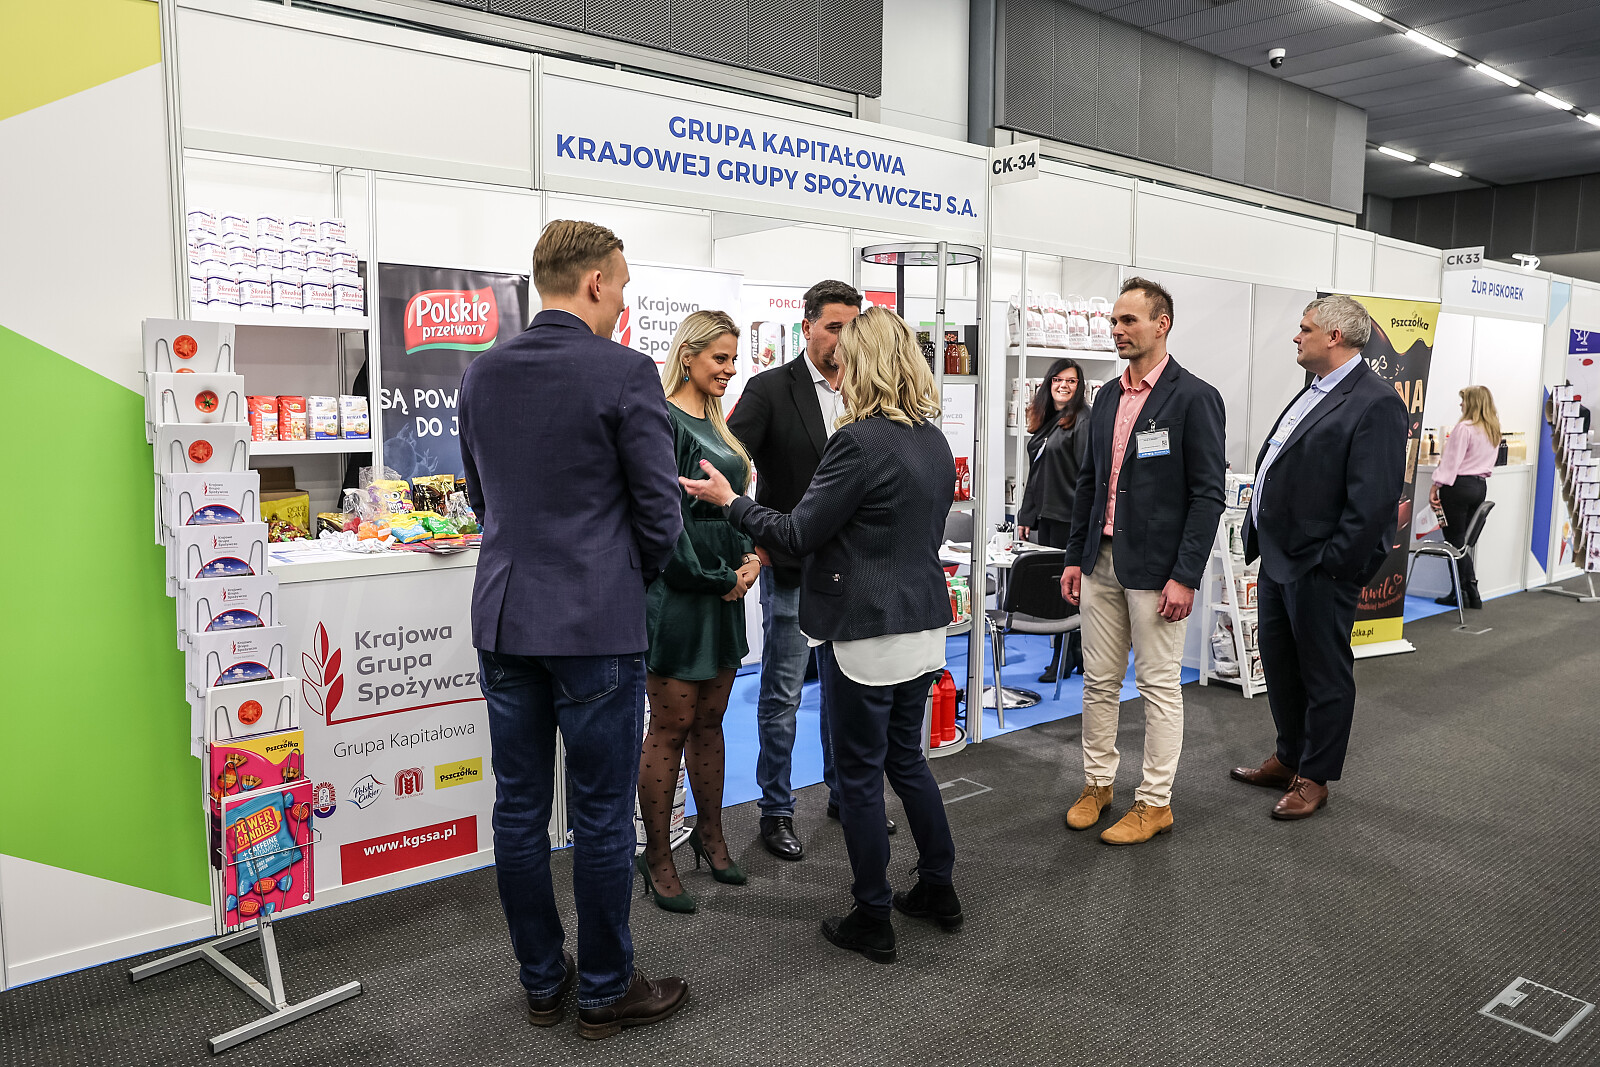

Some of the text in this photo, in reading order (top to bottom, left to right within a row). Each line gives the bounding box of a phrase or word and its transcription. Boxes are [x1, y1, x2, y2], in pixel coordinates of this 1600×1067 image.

[668, 116, 906, 176] GRUPA KAPITAŁOWA
[556, 133, 978, 218] KRAJOWEJ GRUPY SPOŻYWCZEJ S.A.
[992, 152, 1036, 175] CK-34
[1471, 275, 1524, 300] ŻUR PISKOREK
[416, 294, 491, 327] Polskie
[638, 295, 700, 316] Krajowa
[422, 324, 485, 341] przetwory
[639, 316, 681, 335] Grup
[639, 336, 673, 355] Spo
[380, 388, 409, 415] SĄ
[416, 416, 443, 437] DO
[354, 625, 452, 651] Krajowa
[356, 653, 432, 675] Grupa
[333, 723, 475, 758] Grupa Kapitałowa
[353, 782, 374, 799] Polski
[358, 788, 380, 803] Cukier
[234, 810, 273, 838] POWER
[237, 820, 276, 847] CANDIES
[363, 825, 457, 857] www.kgssa.pl
